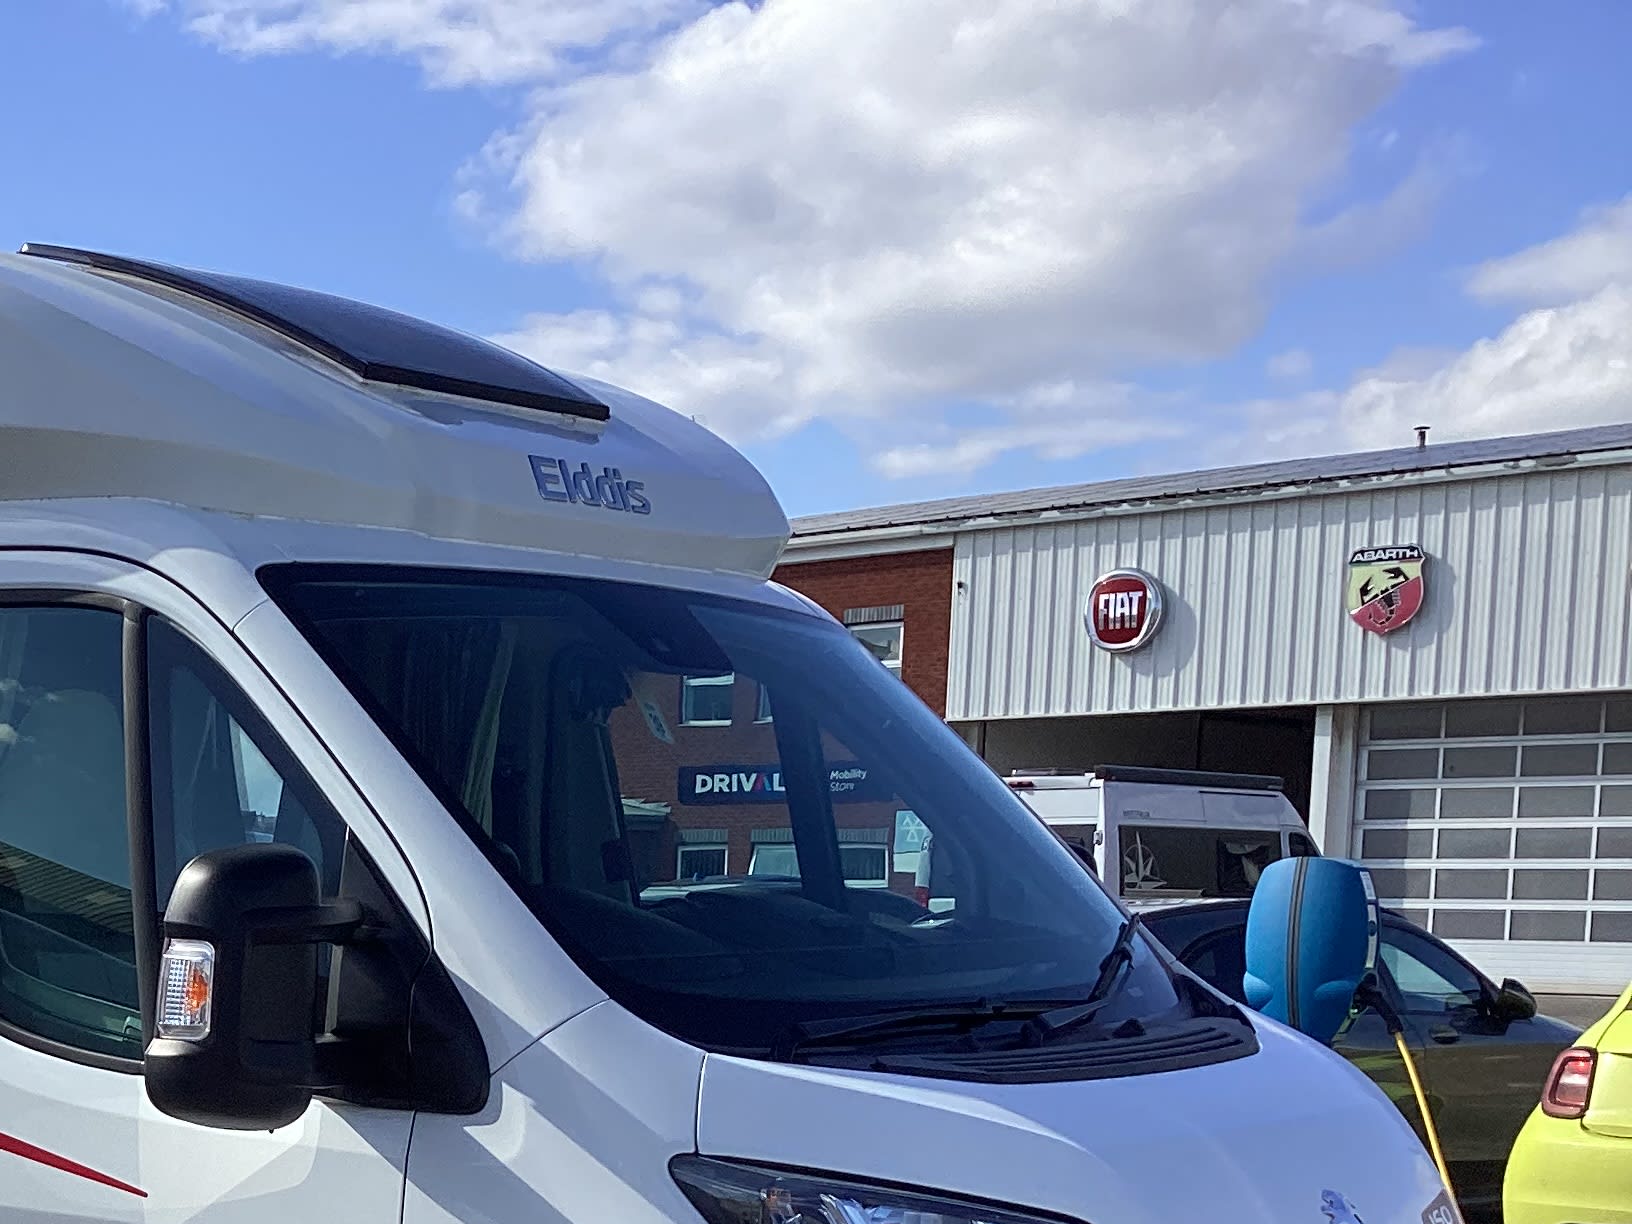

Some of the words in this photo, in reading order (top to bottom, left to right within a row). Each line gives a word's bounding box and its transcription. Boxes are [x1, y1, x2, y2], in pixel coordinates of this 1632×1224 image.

[528, 454, 651, 514] Elddis
[1352, 549, 1418, 562] ABARTH
[1098, 591, 1143, 630] FIAT
[695, 772, 786, 793] DRIVAL
[830, 769, 867, 779] Mobility
